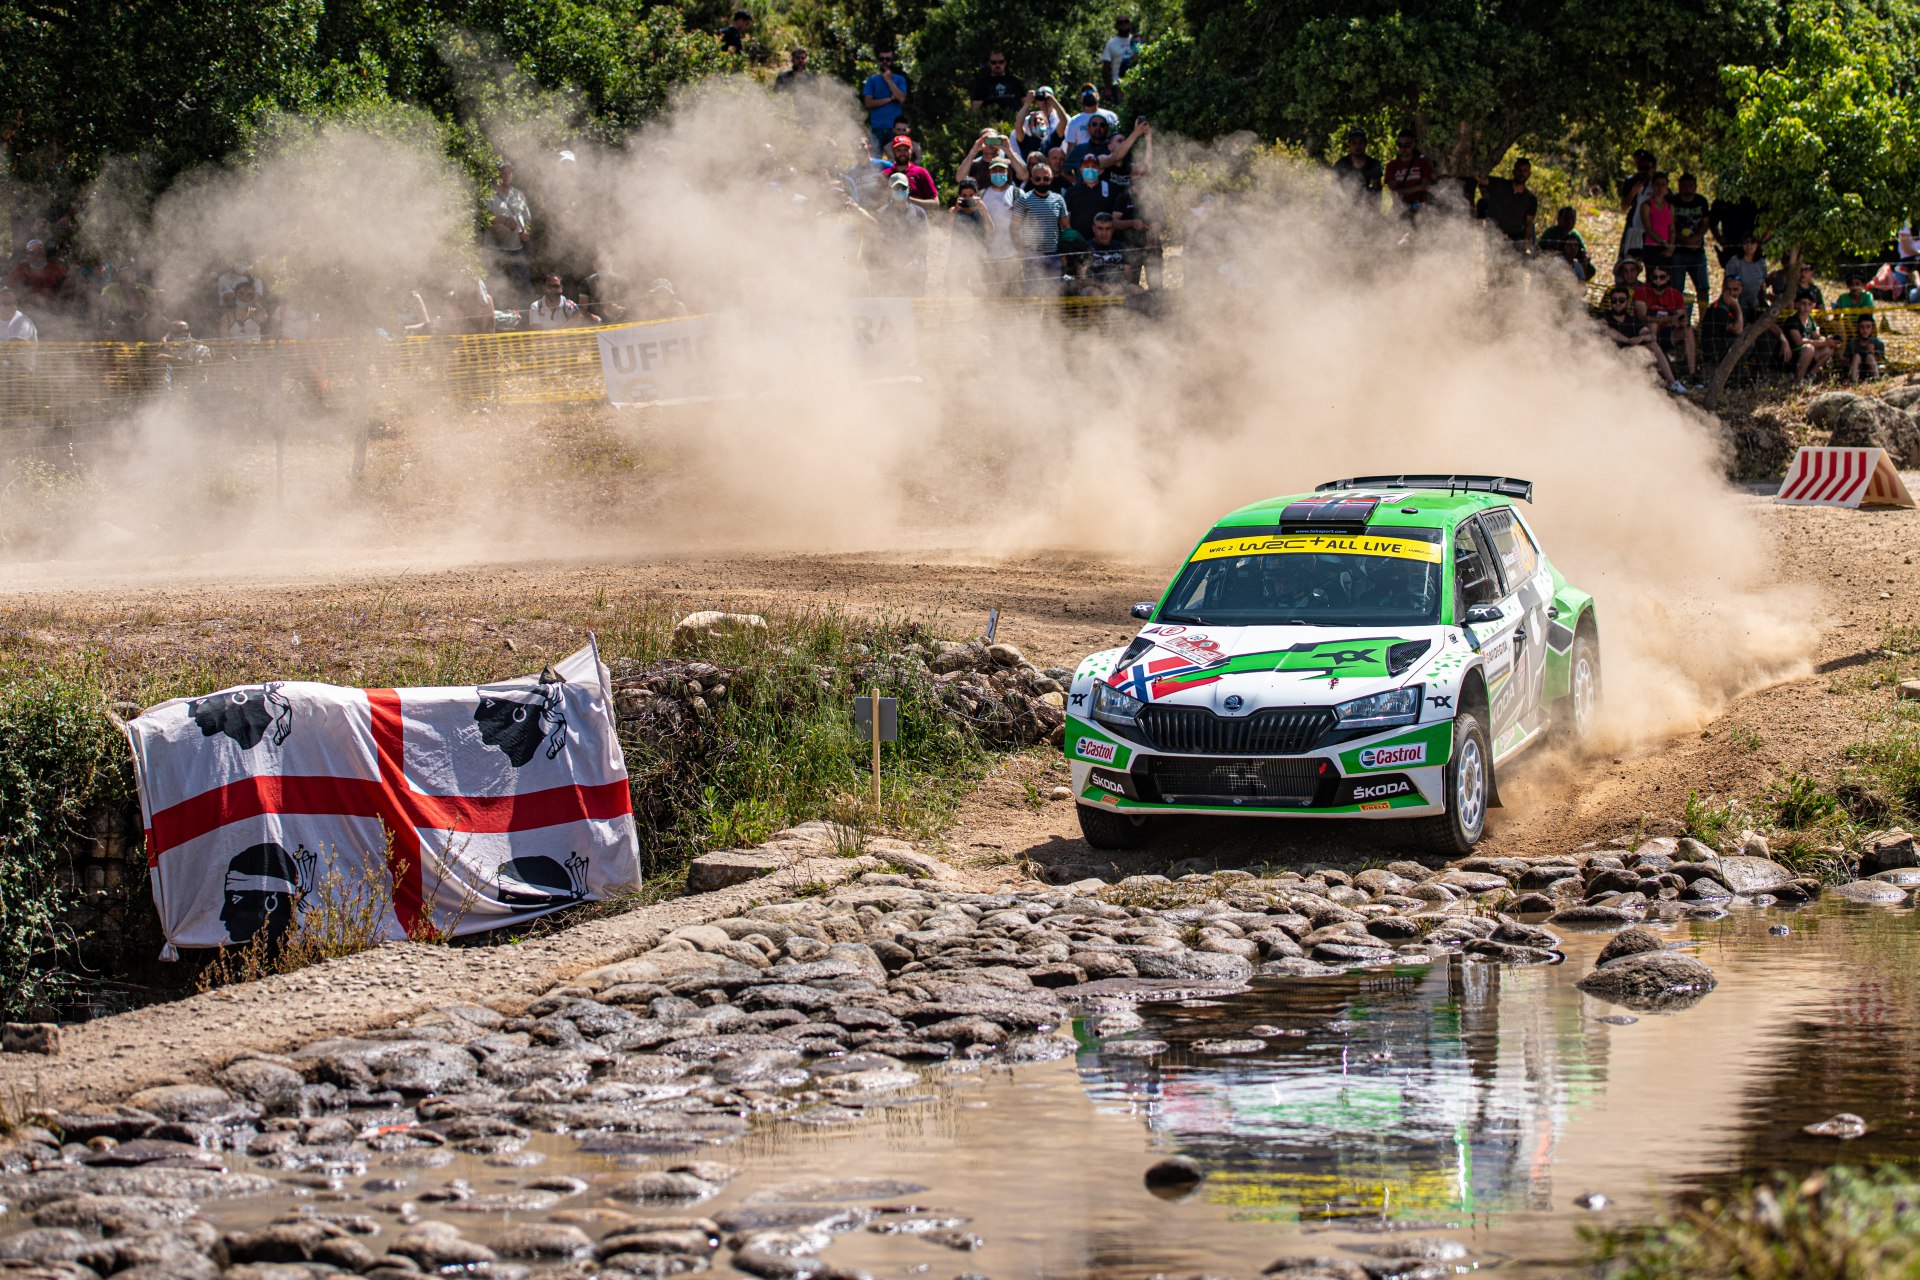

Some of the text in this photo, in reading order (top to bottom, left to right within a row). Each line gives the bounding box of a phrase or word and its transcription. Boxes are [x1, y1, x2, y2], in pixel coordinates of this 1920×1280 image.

[1325, 539, 1358, 550] ALL
[1363, 540, 1403, 554] LIVE
[1085, 741, 1114, 760] Castrol
[1376, 745, 1422, 765] Castrol
[1091, 772, 1125, 795] ŠKODA
[1353, 781, 1410, 800] ŠKODA
